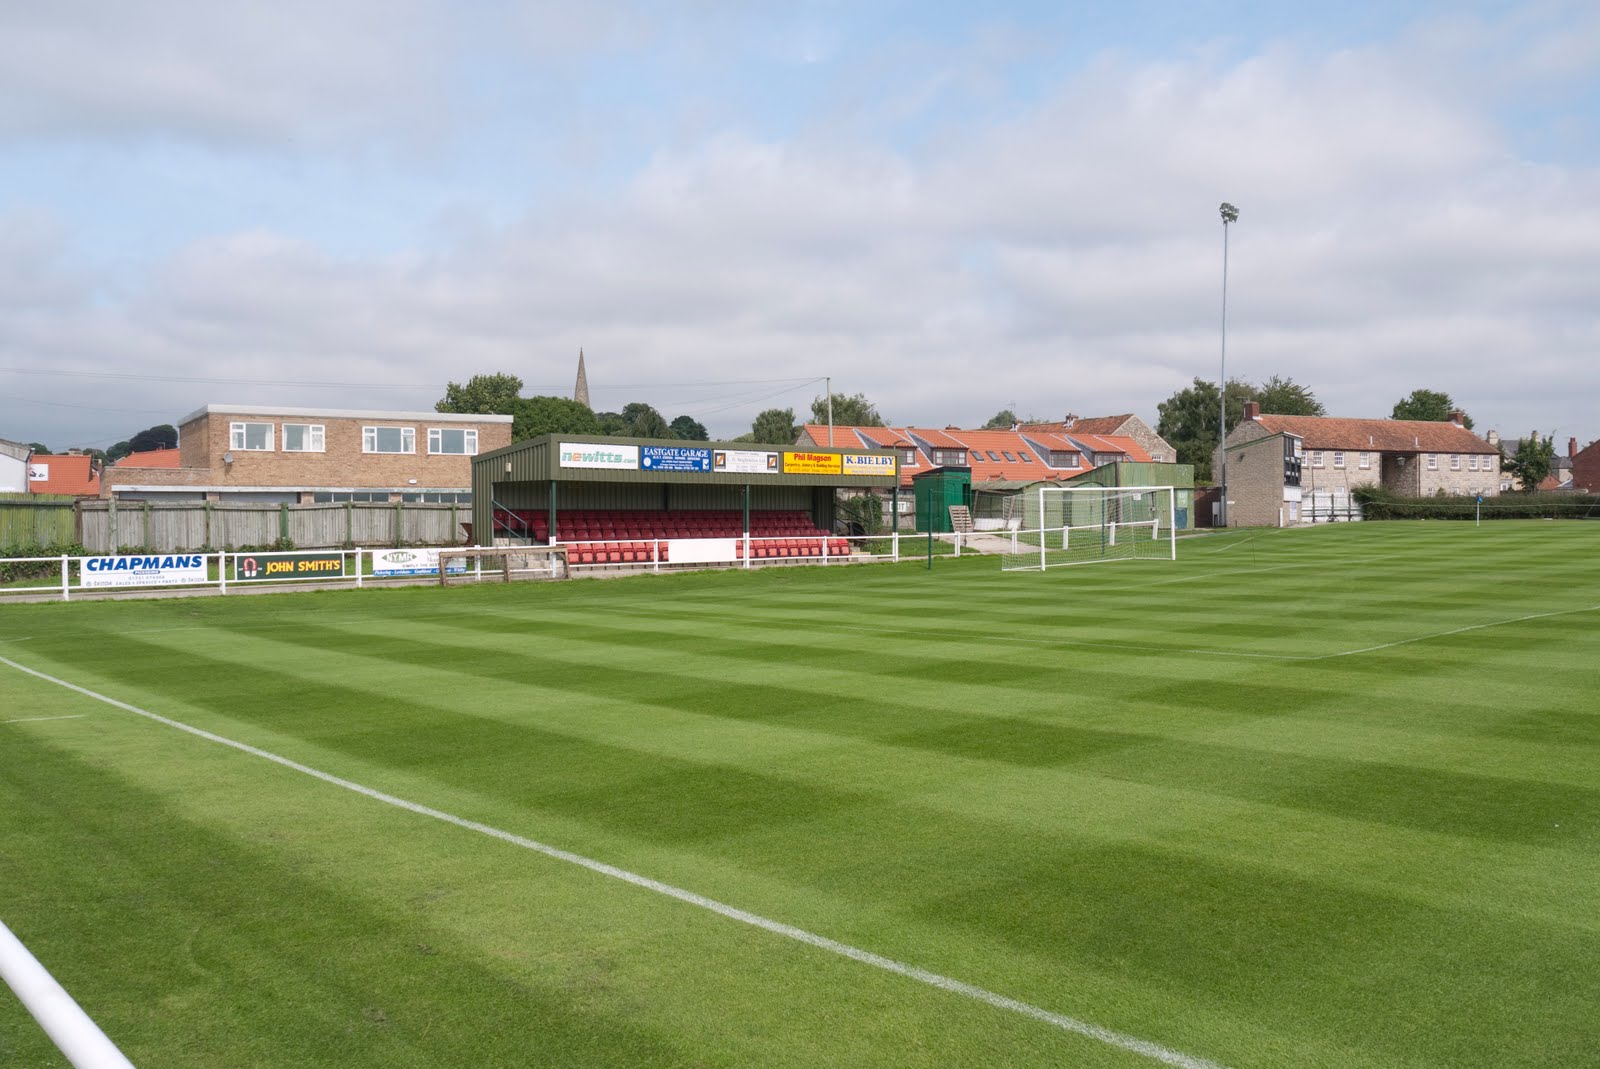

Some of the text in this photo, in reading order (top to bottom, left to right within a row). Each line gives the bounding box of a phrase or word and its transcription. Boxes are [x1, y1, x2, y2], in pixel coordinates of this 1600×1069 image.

[561, 450, 637, 464] newitts.com
[644, 447, 709, 458] EASTGATE GARAGE
[793, 453, 832, 463] Phil Magson
[86, 555, 203, 572] CHAPMANS
[386, 552, 413, 563] NYMR
[265, 559, 341, 575] JOHN SMITH'S
